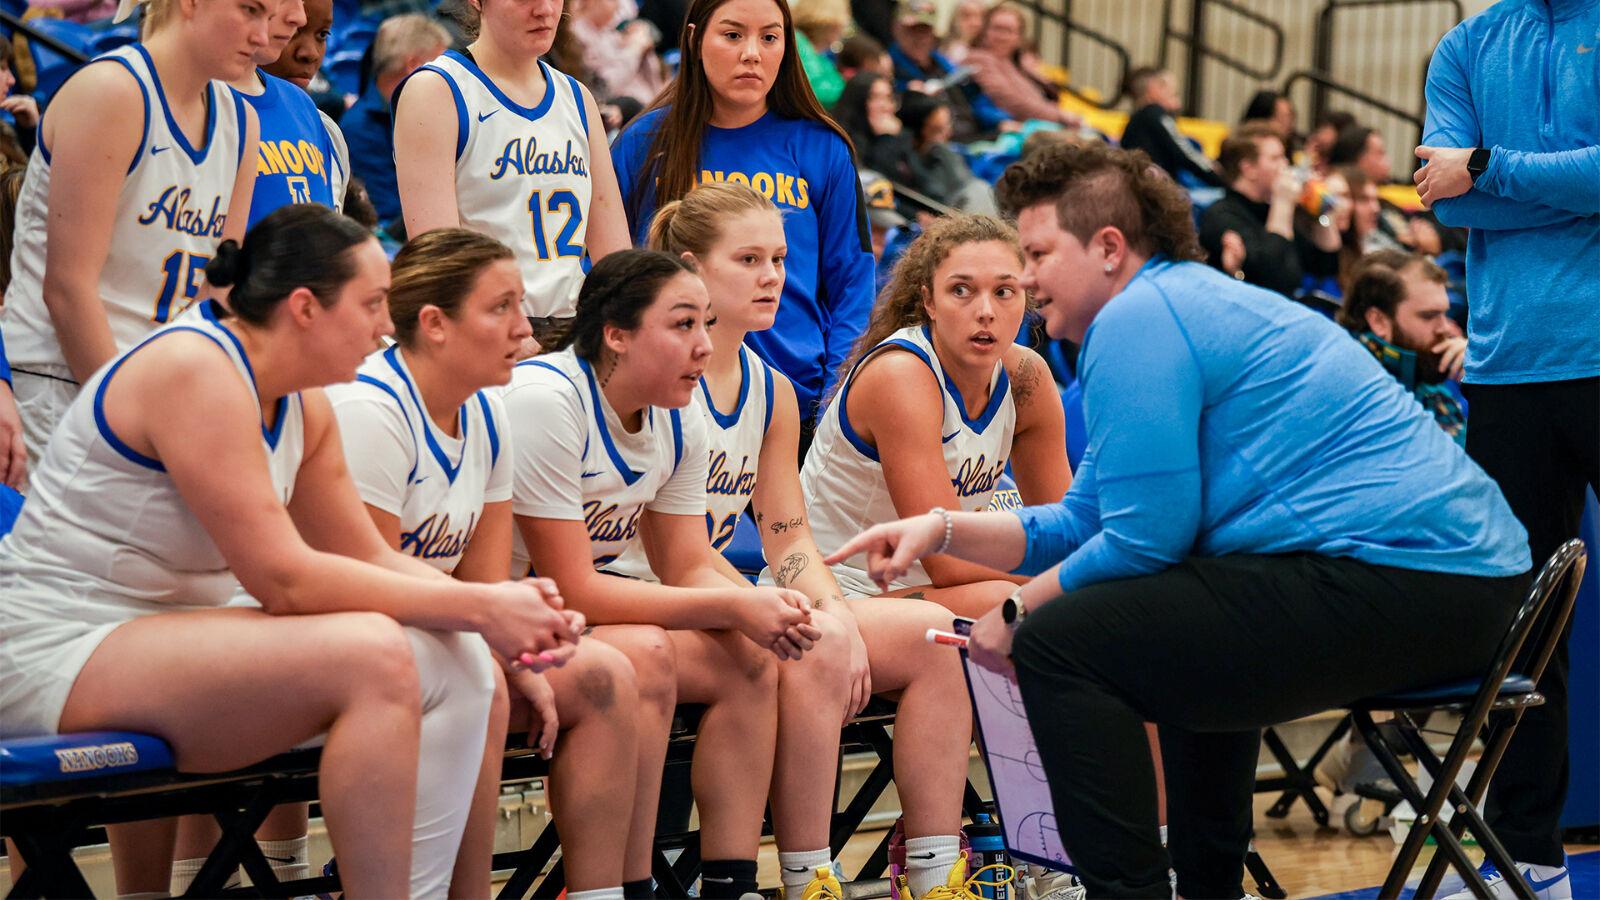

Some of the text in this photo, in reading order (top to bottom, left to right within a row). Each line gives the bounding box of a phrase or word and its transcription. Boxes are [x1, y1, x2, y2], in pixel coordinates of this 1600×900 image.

[490, 136, 588, 180] Alaska
[528, 189, 583, 261] 12
[152, 248, 217, 324] 15
[57, 744, 138, 772] NANOOKS
